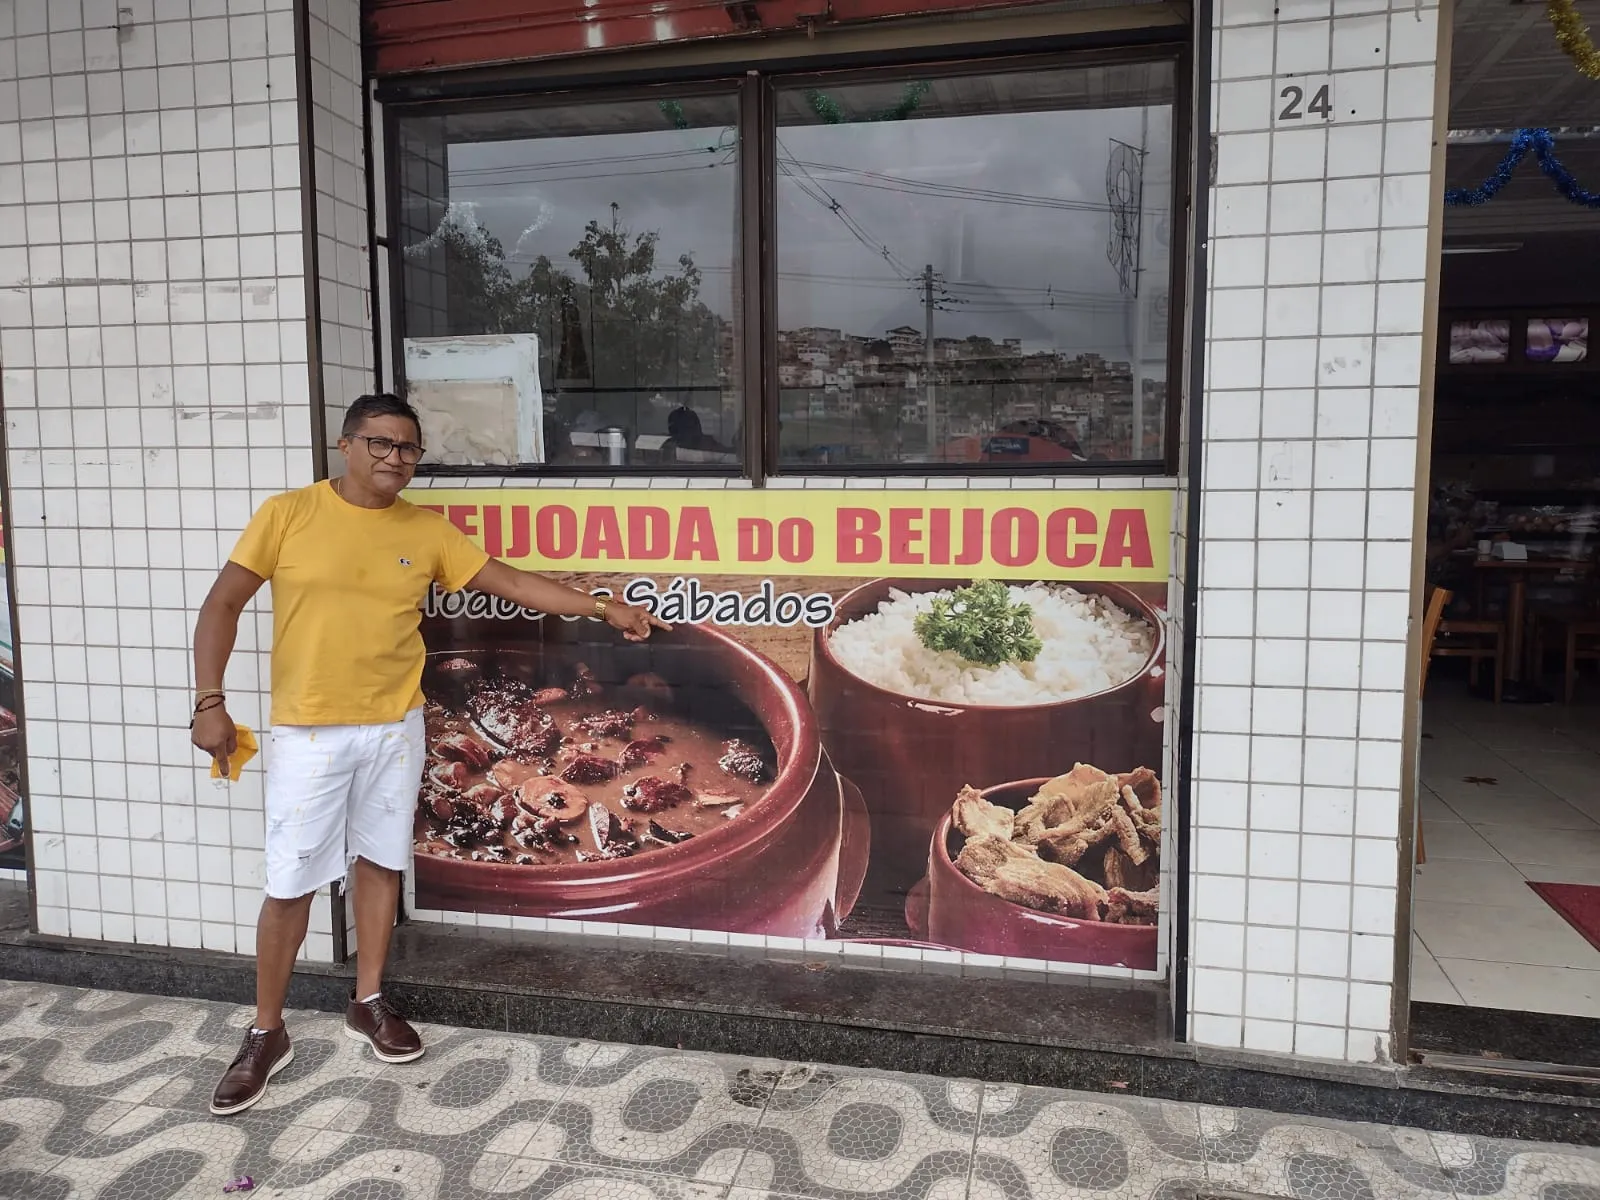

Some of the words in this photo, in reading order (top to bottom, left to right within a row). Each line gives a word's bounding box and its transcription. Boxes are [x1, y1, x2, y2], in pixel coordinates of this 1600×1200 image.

[1278, 84, 1333, 120] 24
[417, 505, 720, 561] EIJOADA
[737, 517, 814, 563] DO
[836, 507, 1154, 568] BEIJOCA
[625, 578, 833, 626] Sábados
